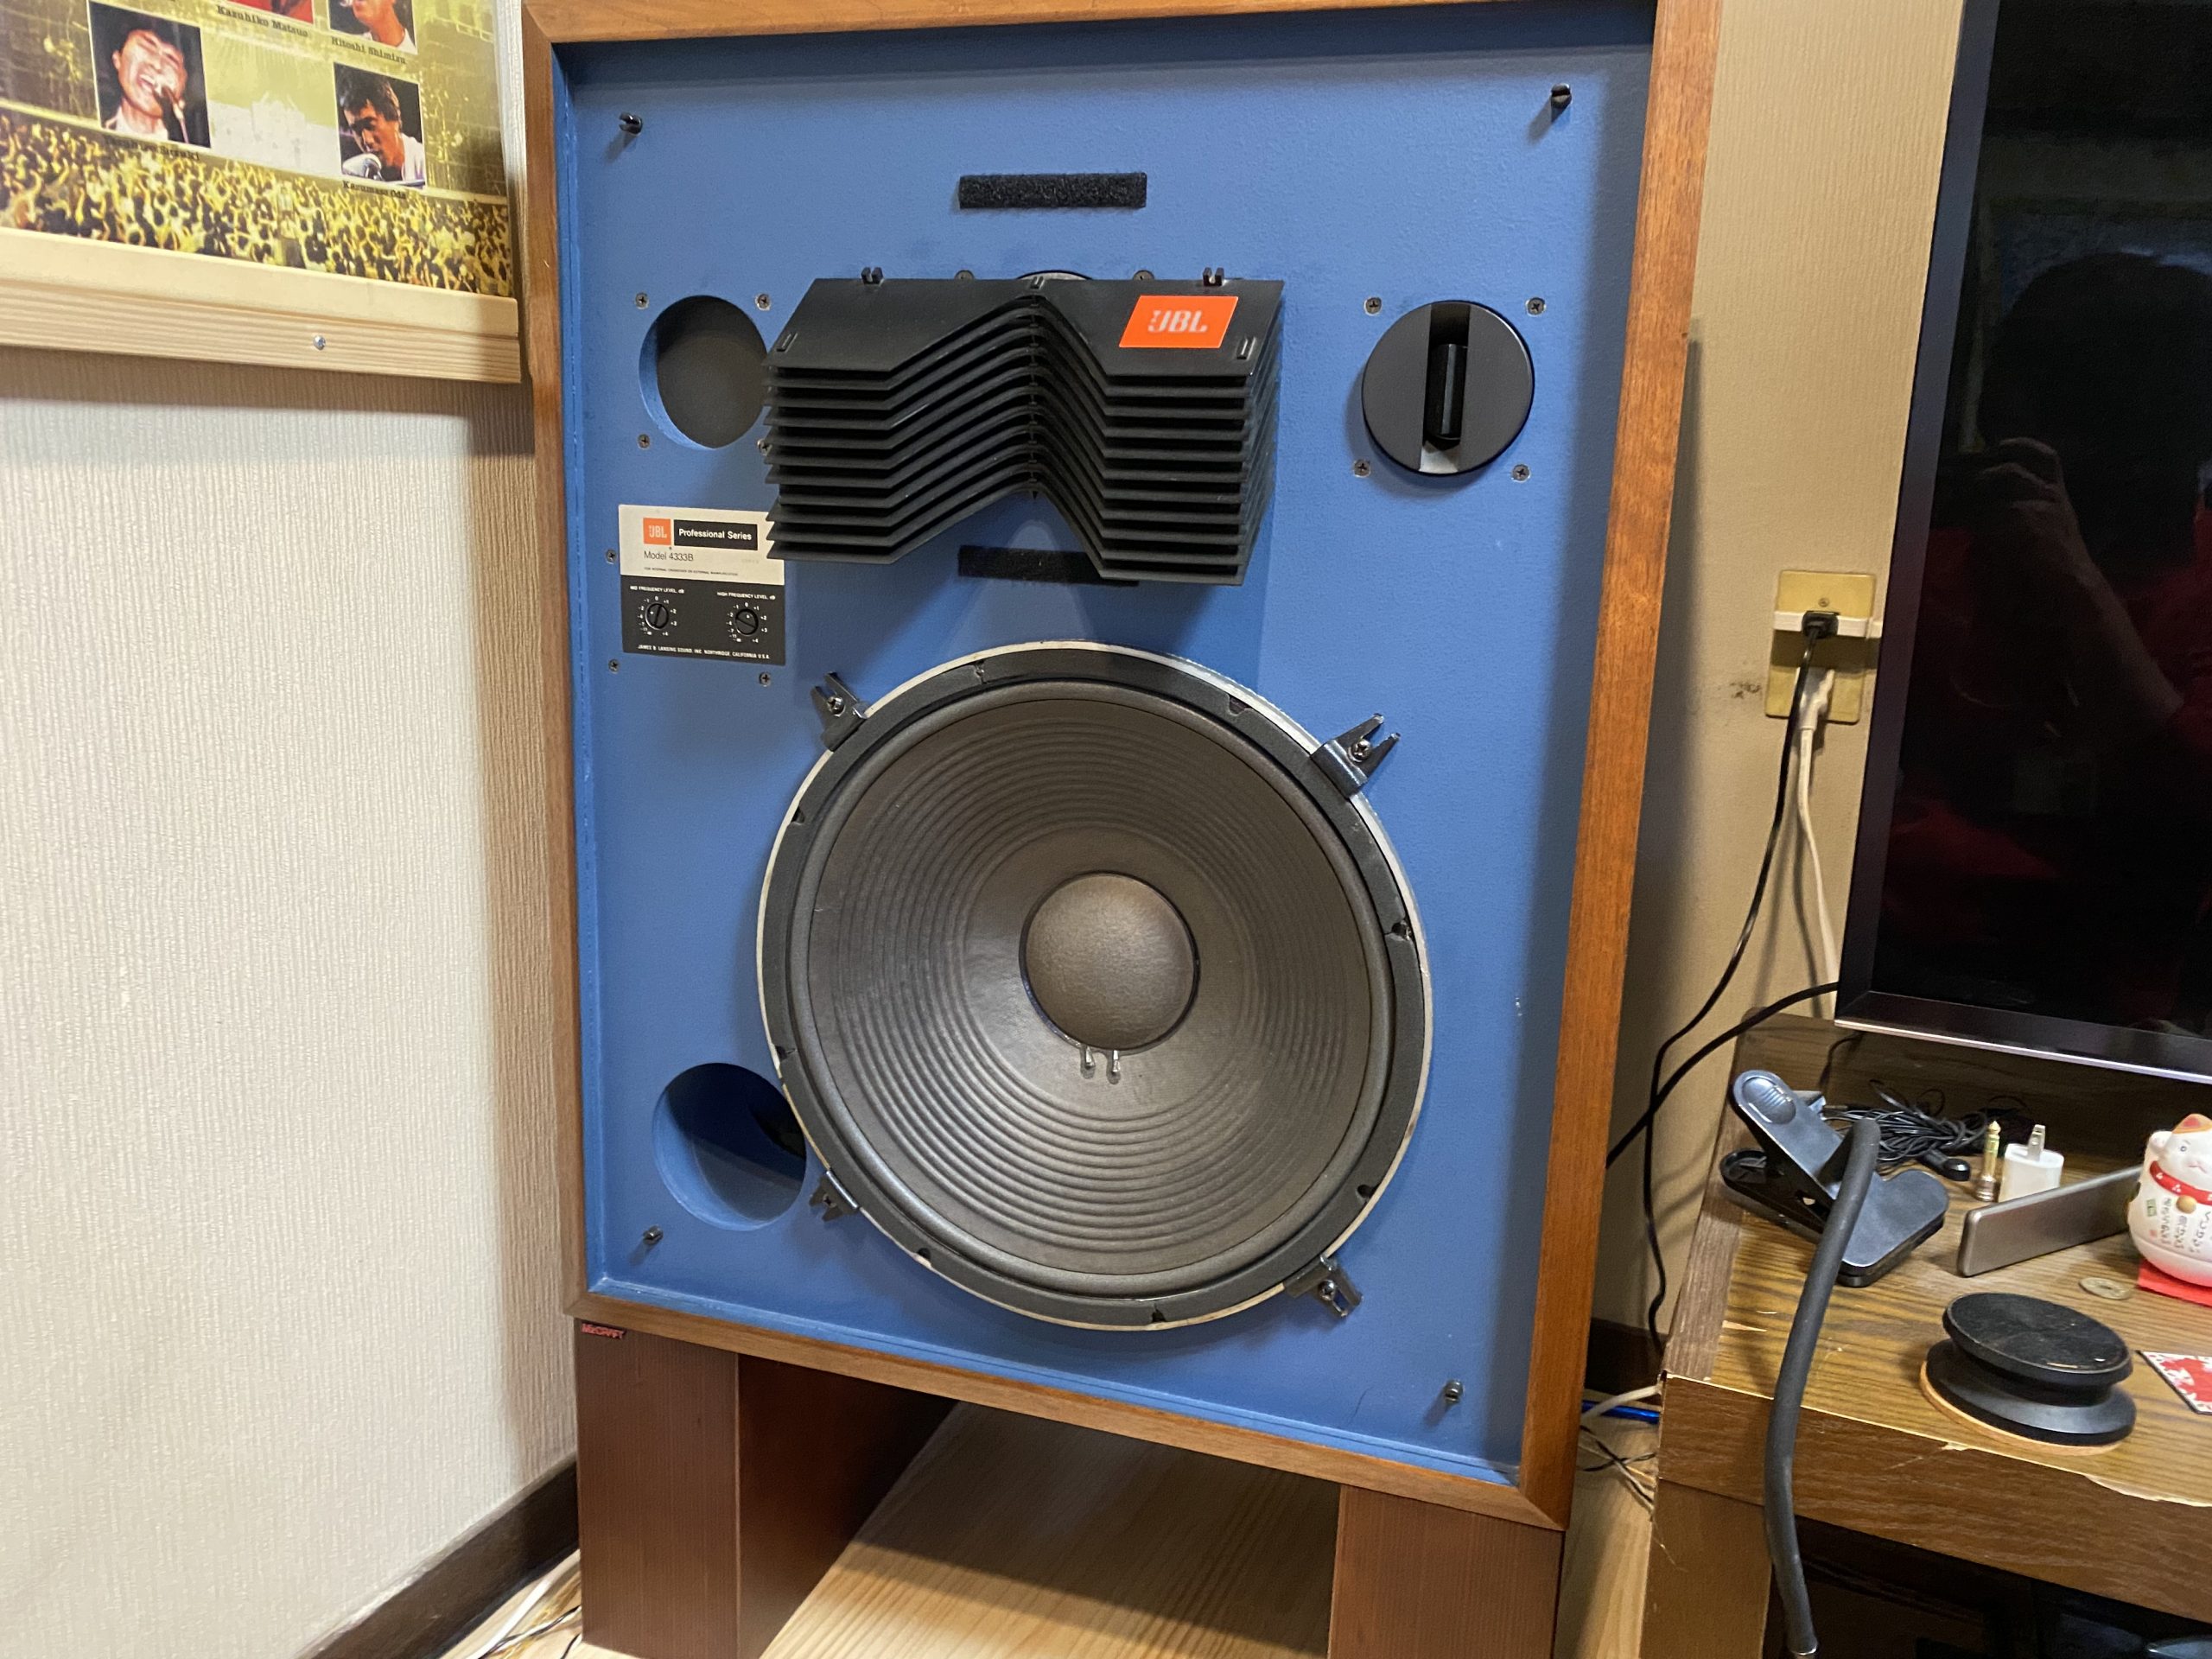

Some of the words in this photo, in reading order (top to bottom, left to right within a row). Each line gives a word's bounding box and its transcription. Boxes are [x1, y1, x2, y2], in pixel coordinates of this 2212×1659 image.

[217, 5, 269, 27] Kazuhiko
[272, 21, 308, 37] Matsuo
[331, 36, 365, 54] Hitoshi
[368, 47, 406, 64] Shimizu
[1147, 309, 1208, 333] JBL
[648, 525, 667, 538] JBL
[678, 528, 725, 538] Professional
[728, 531, 752, 541] Series
[644, 550, 667, 561] Model
[669, 552, 694, 562] 4333B
